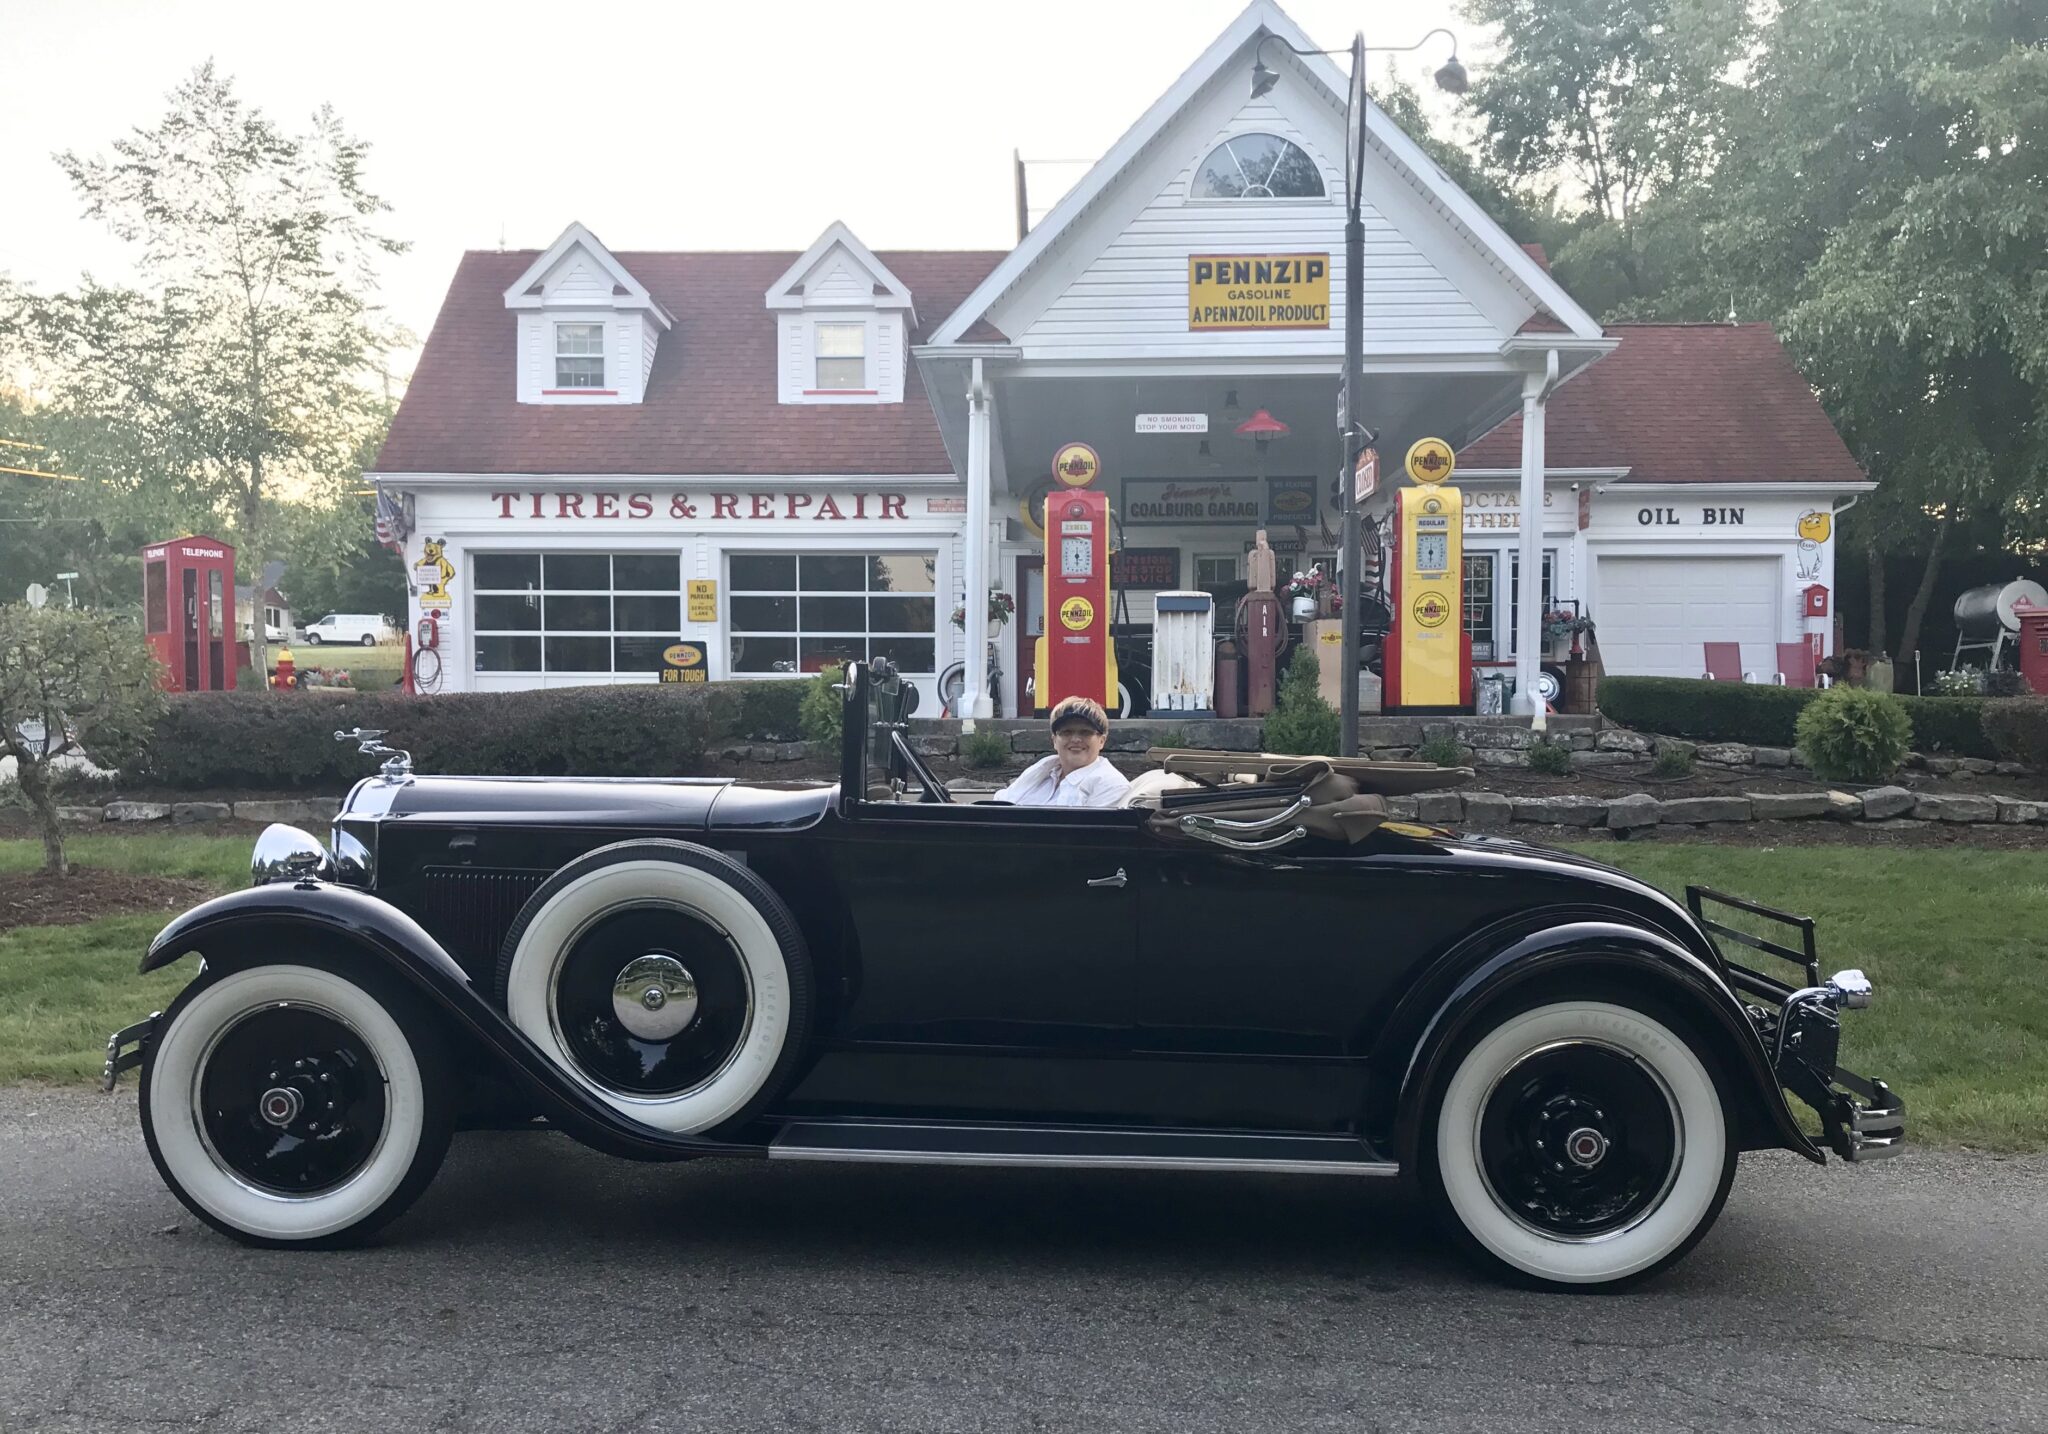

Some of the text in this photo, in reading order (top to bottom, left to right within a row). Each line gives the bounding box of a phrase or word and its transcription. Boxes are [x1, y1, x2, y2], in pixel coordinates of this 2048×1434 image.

[1194, 260, 1324, 285] PENNZIP
[1227, 289, 1292, 300] GASOLINE
[1192, 303, 1327, 323] A PENNZOIL PRODUCT
[1059, 462, 1095, 472] PENNZOIL
[1413, 455, 1449, 467] PENNZOIL
[491, 492, 654, 519] TIRES
[669, 492, 698, 519] &
[710, 492, 910, 519] REPAIR
[1463, 492, 1553, 508] OCTAE
[1130, 502, 1259, 517] COALBURG GARAG
[1637, 508, 1745, 525] OIL BIN
[182, 548, 224, 558] TELEPHONE
[1113, 575, 1173, 583] SERVICE
[696, 584, 708, 593] NO
[1061, 609, 1092, 618] PENNZOIL
[1415, 605, 1448, 614] PENNZOIL
[662, 668, 706, 682] FOR TOUGH
